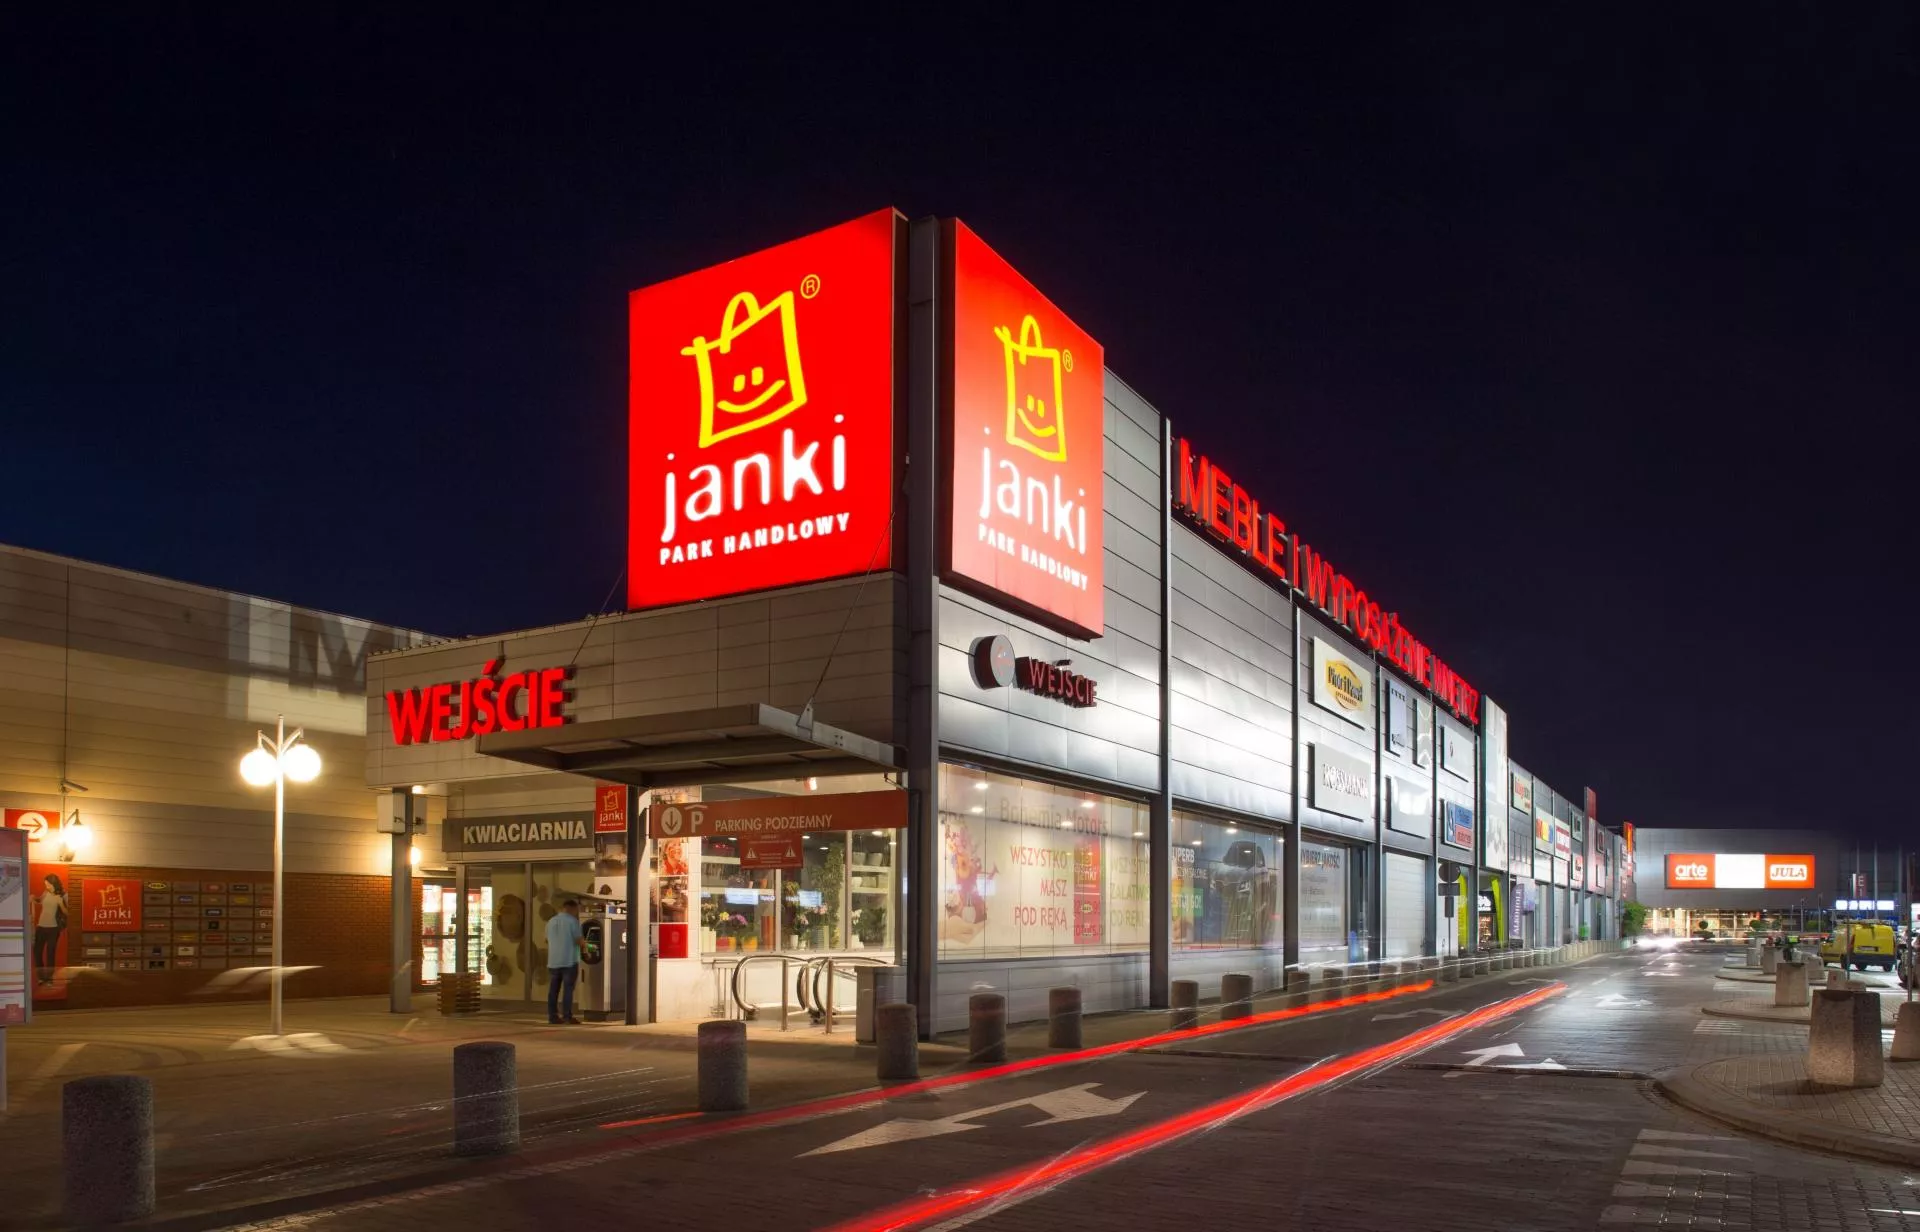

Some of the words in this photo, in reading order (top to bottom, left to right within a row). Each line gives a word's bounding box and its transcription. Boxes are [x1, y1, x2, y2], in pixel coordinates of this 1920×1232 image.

[660, 414, 848, 543] janki
[979, 427, 1087, 555] janki
[659, 539, 713, 565] PARK
[724, 513, 850, 554] HANDLOWY
[978, 525, 1016, 557] PARK
[1020, 547, 1088, 592] HANDLOWY
[1180, 437, 1286, 578] MEBLE
[1291, 534, 1300, 588] I
[1305, 546, 1431, 689] WYPOSAŻENIE
[1029, 659, 1097, 706] WEJŚCIE
[386, 658, 565, 746] WEJŚCIE
[599, 808, 624, 823] janki
[715, 816, 762, 832] PARKING
[765, 815, 832, 829] PODZIEMNY
[1000, 797, 1062, 830] Bohemia
[1067, 808, 1109, 837] Motors
[463, 820, 587, 845] KWIACIARNIA
[1010, 845, 1068, 869] WSZYSTKO
[1675, 863, 1708, 877] arte
[1772, 867, 1806, 878] JULA
[1040, 879, 1068, 897] MASZ
[93, 906, 132, 921] janki
[1014, 905, 1037, 926] POD
[1040, 906, 1068, 931] RĘKĄ
